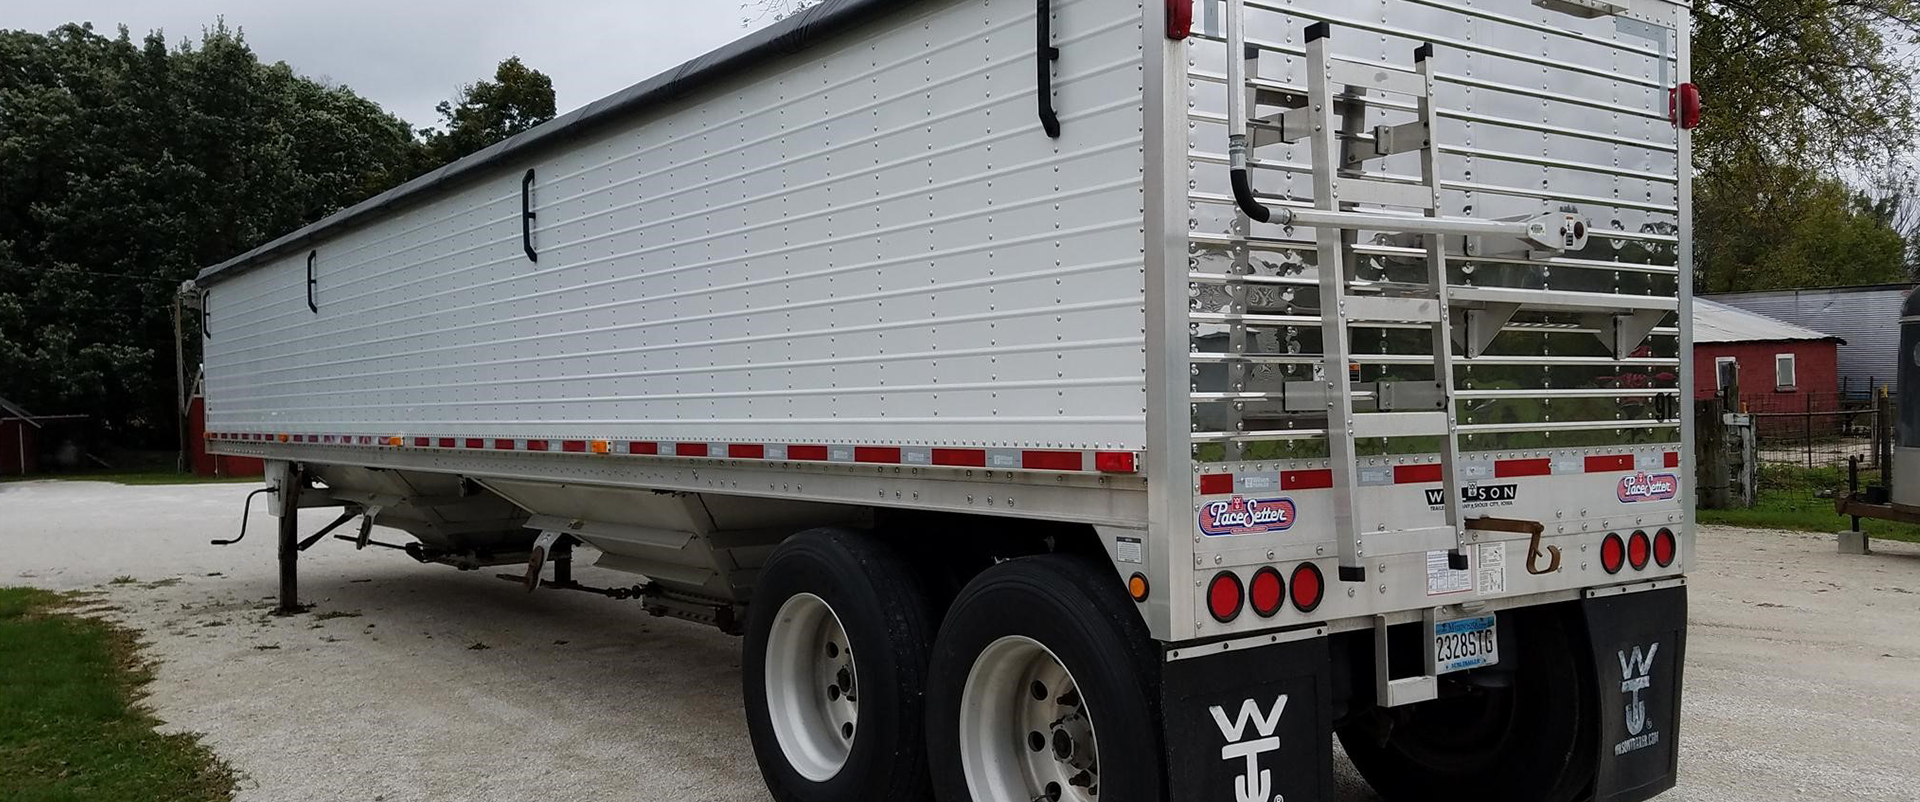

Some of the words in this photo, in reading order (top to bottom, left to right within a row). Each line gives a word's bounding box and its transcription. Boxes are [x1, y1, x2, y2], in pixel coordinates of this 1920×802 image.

[1624, 474, 1672, 497] PaceSetter
[1210, 499, 1288, 528] PaceSetter
[1436, 629, 1494, 662] 2328STG
